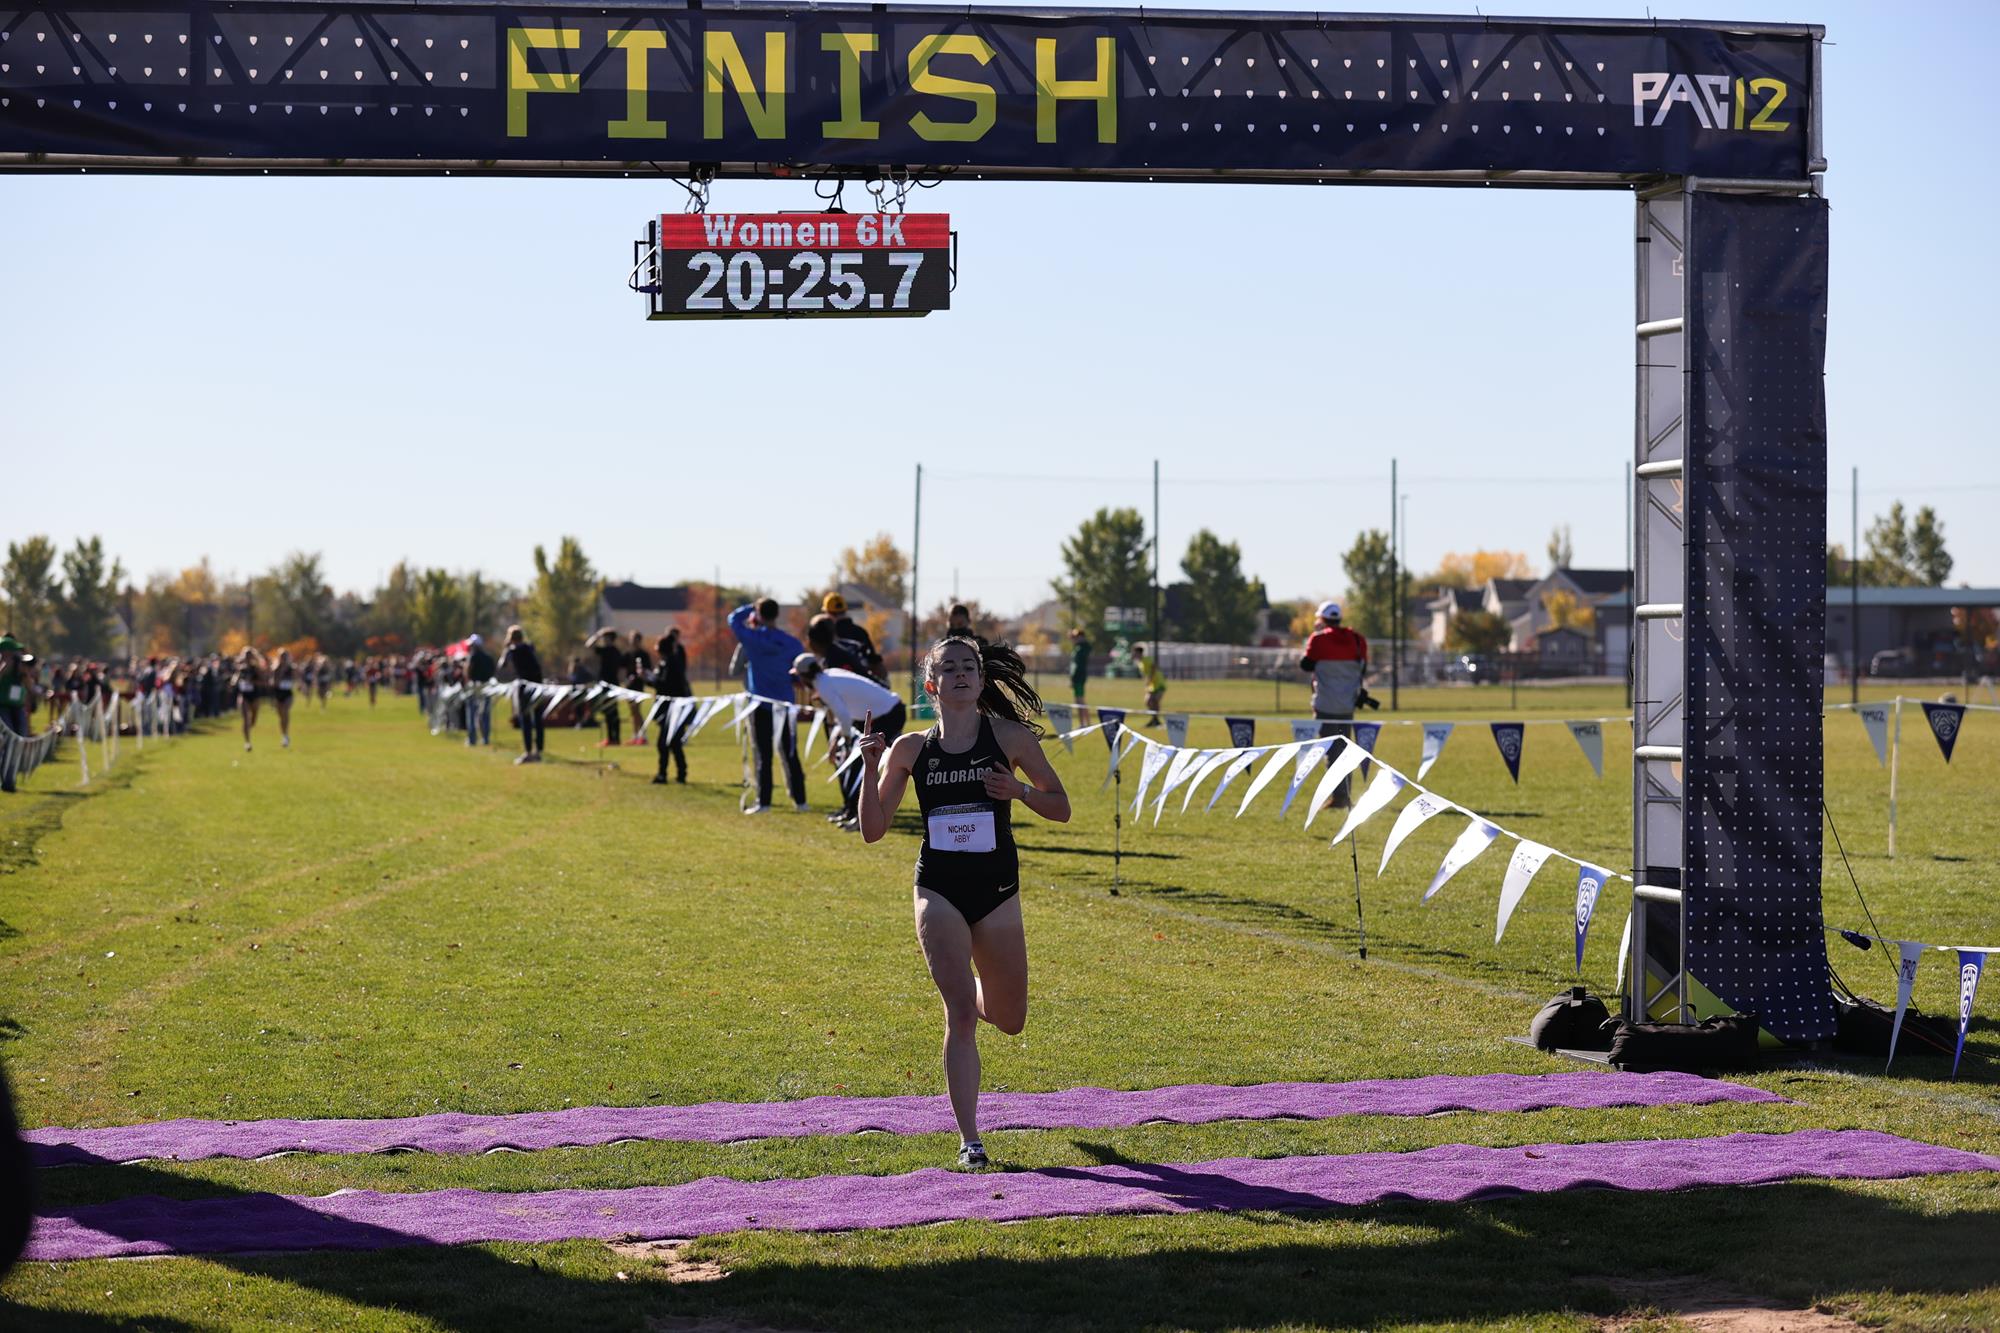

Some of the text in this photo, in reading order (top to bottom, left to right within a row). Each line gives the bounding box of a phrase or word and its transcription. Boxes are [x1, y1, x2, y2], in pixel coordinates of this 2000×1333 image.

[507, 28, 1117, 143] FINISH
[702, 214, 906, 247] Women 6K
[685, 251, 924, 311] 20:25.7
[948, 824, 976, 834] NICHOLS
[954, 834, 971, 844] ABBY
